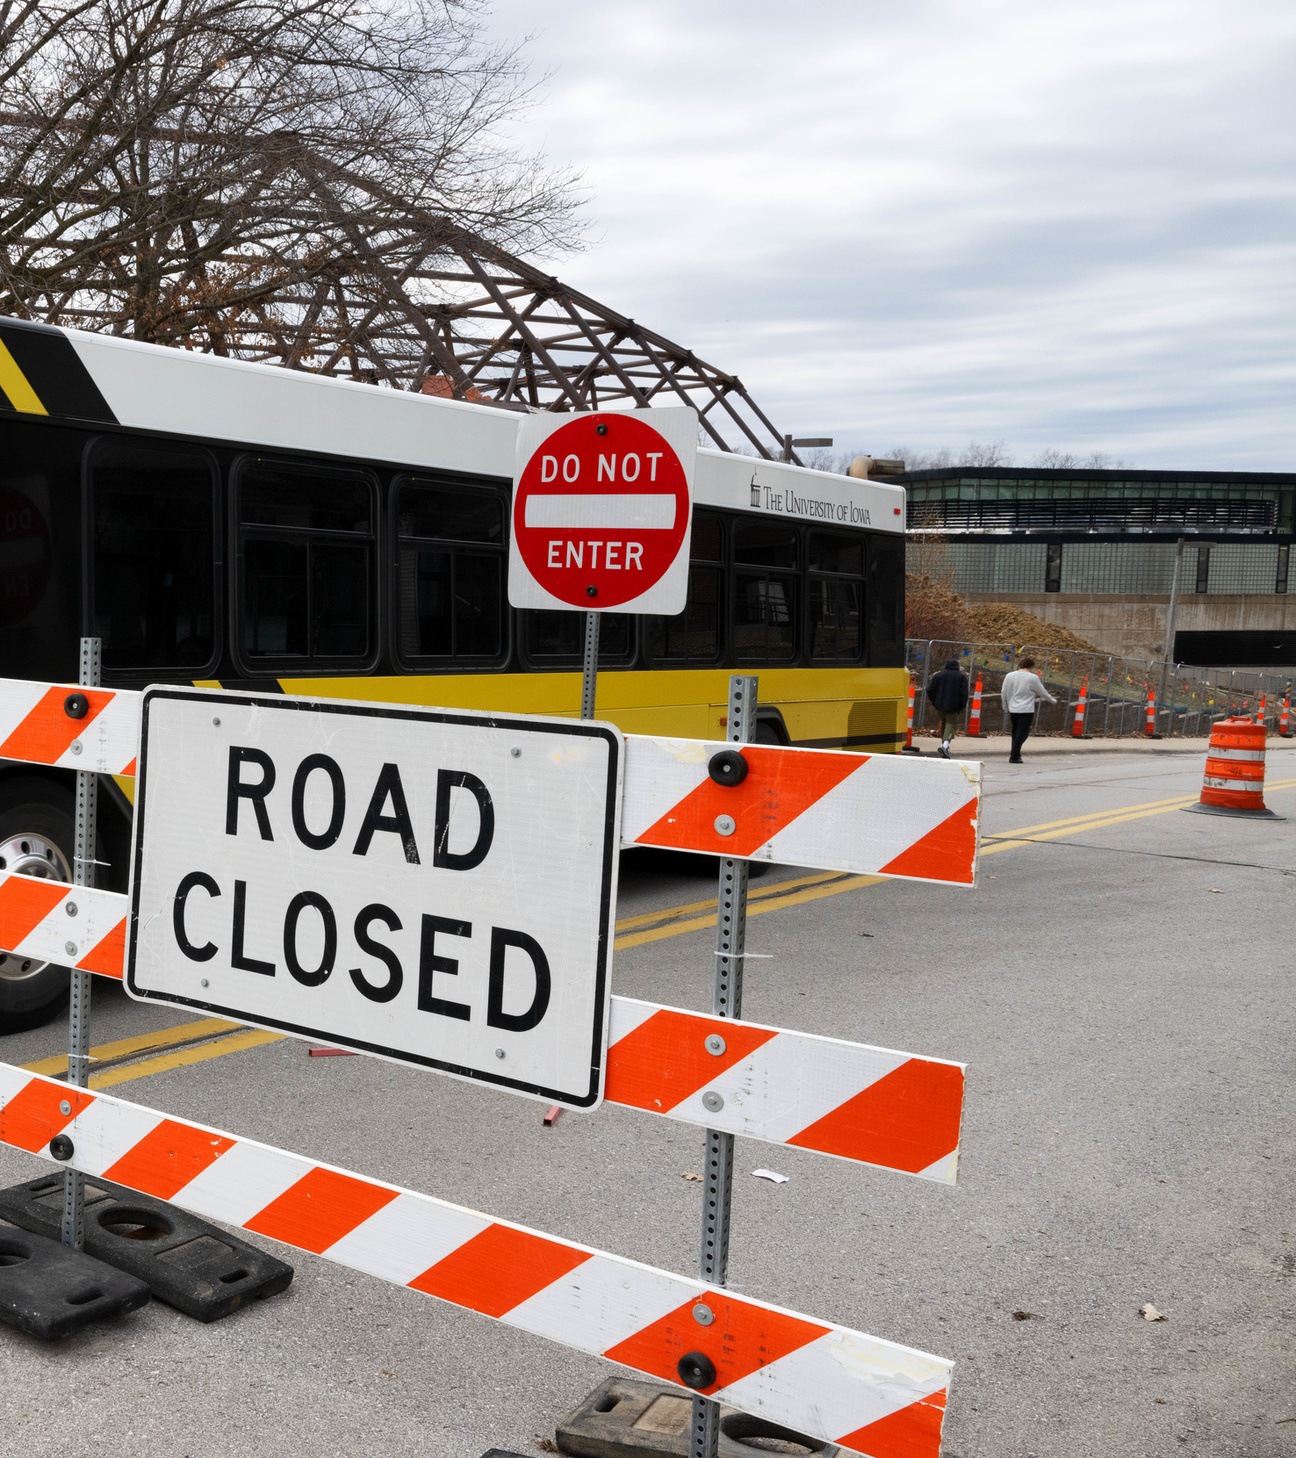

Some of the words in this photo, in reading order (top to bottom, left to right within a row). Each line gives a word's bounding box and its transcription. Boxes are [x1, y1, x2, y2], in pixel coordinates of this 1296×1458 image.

[541, 454, 581, 483] DO
[597, 452, 663, 482] NOT
[763, 486, 782, 511] THE
[785, 489, 836, 519] UNIVERSITY
[837, 504, 848, 521] OF
[850, 501, 871, 525] IOWA
[547, 540, 644, 571] ENTER
[225, 745, 495, 871] ROAD
[173, 871, 552, 1033] CLOSED
